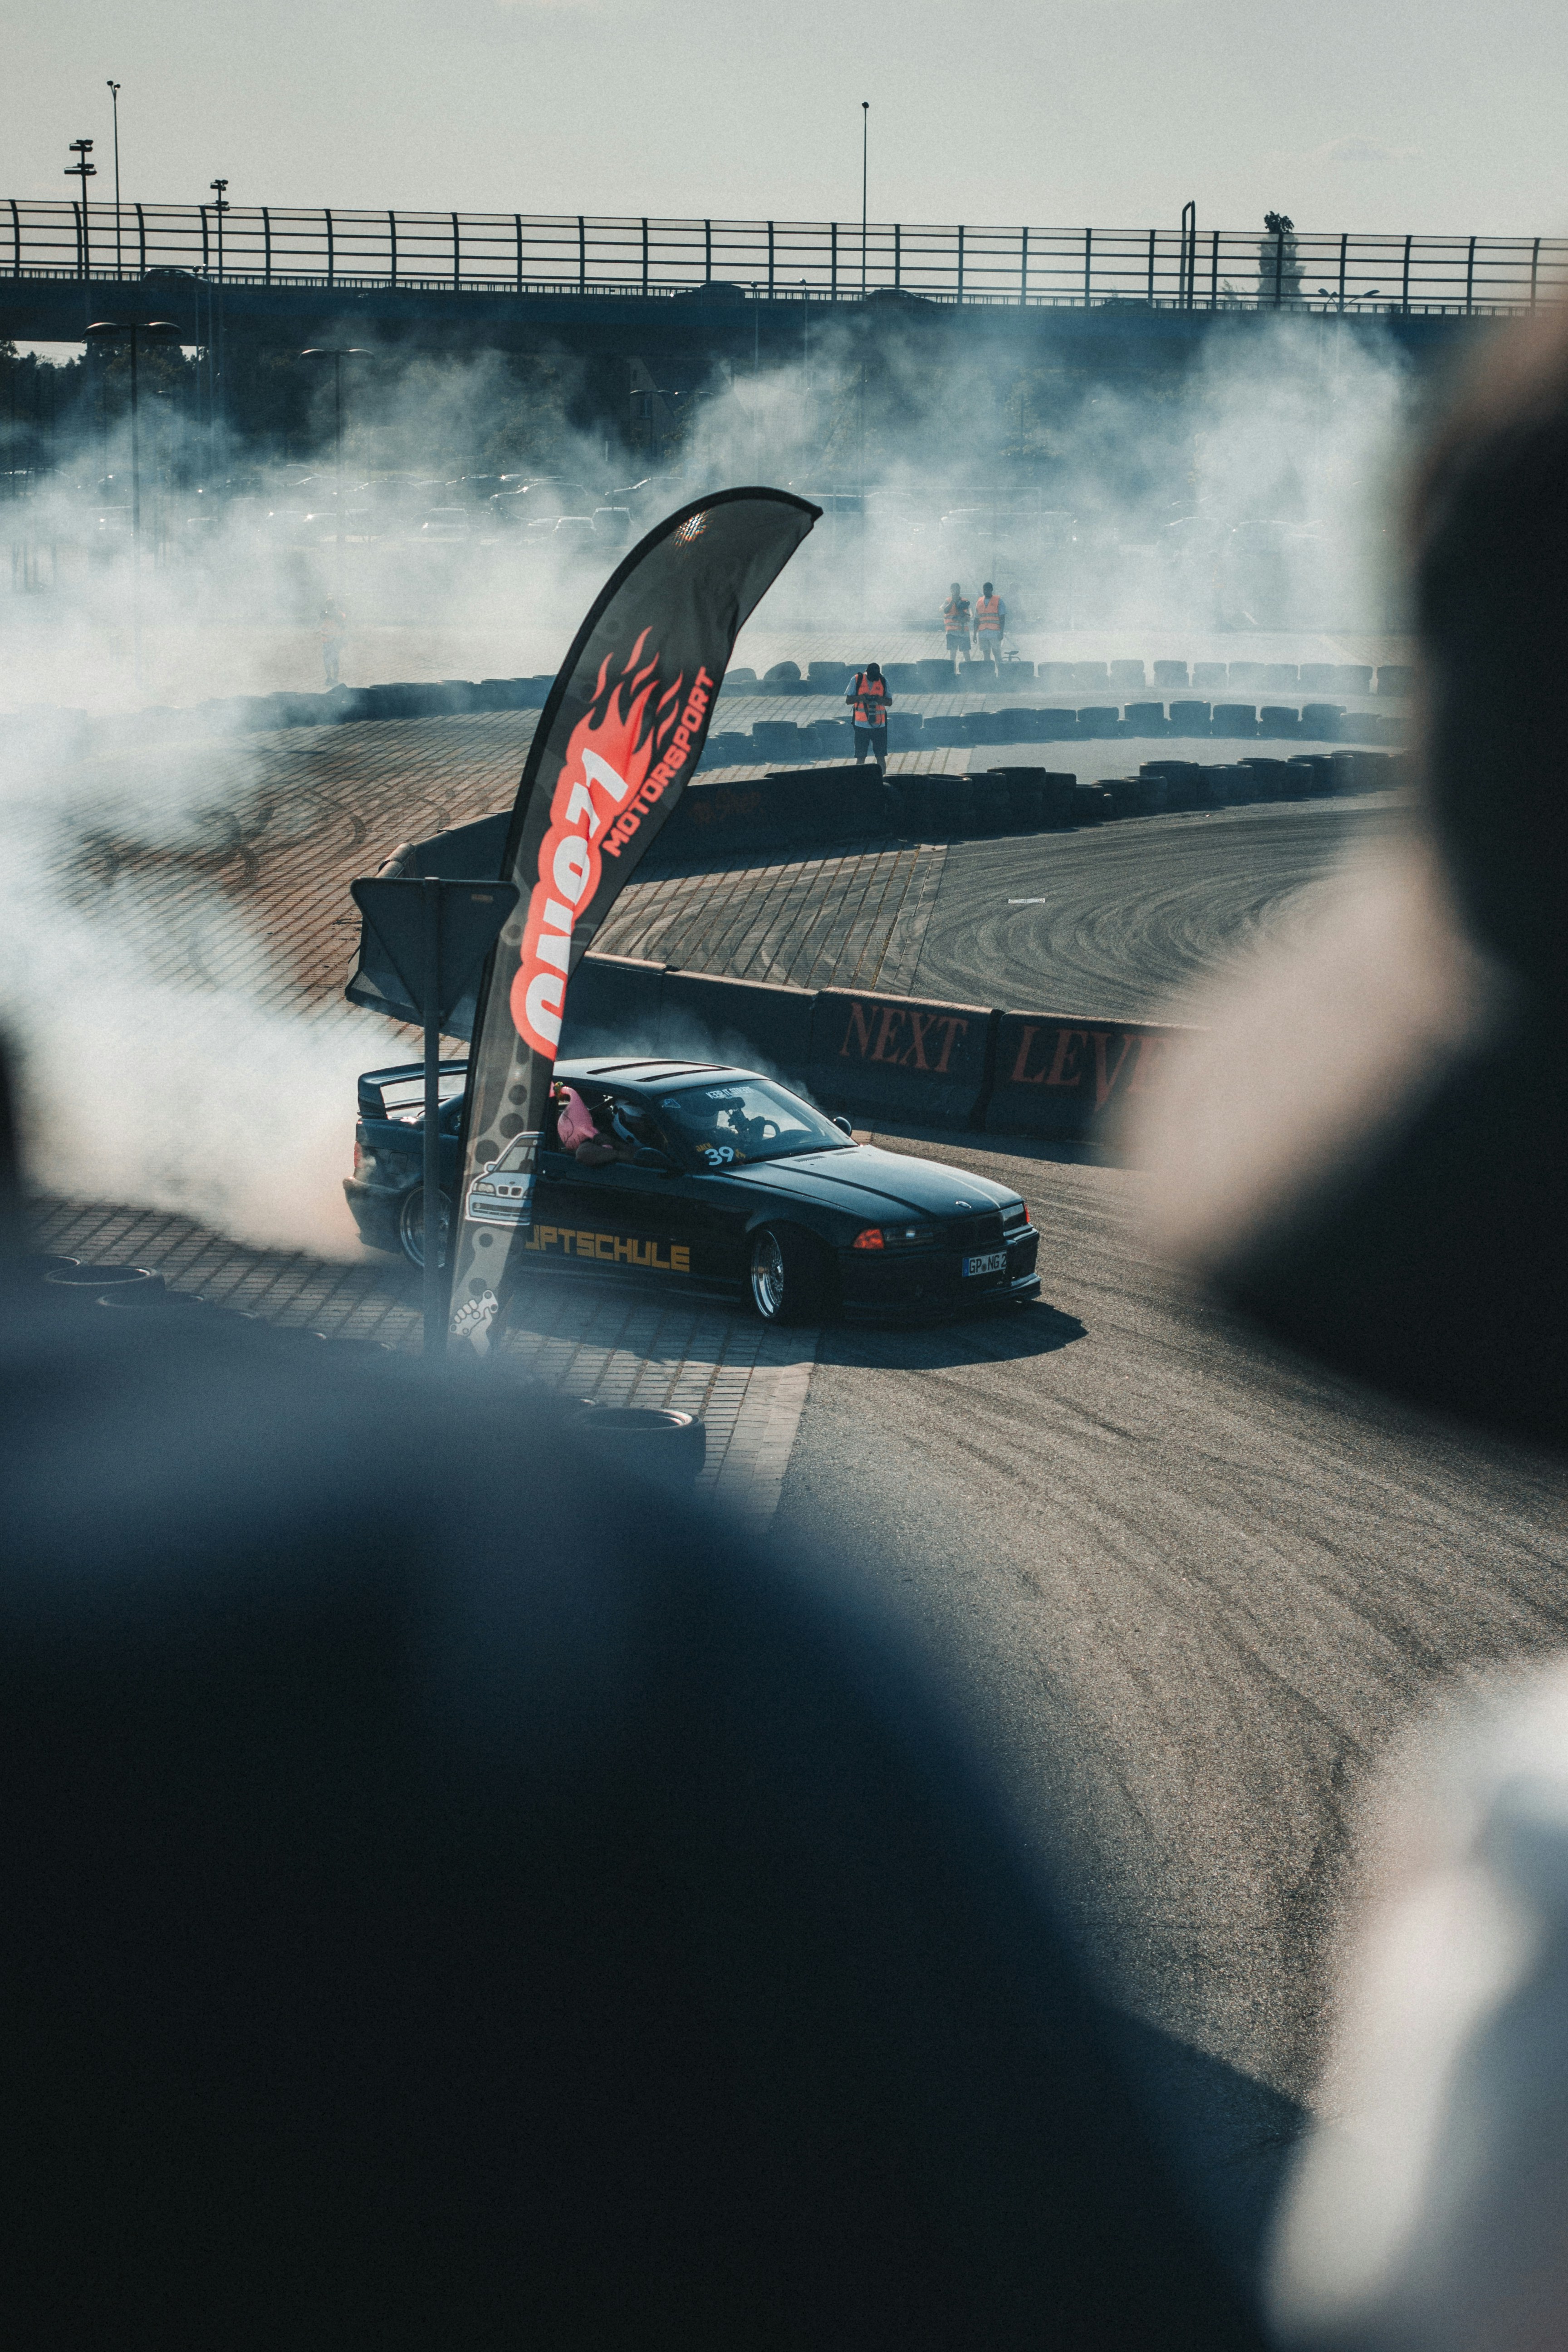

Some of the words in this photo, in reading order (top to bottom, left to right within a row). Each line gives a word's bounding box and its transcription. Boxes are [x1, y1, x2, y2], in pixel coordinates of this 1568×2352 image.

[602, 666, 714, 858] MOTORSPORT
[839, 1002, 969, 1073] NEXT
[705, 1146, 734, 1166] 39
[969, 1259, 982, 1274] GP
